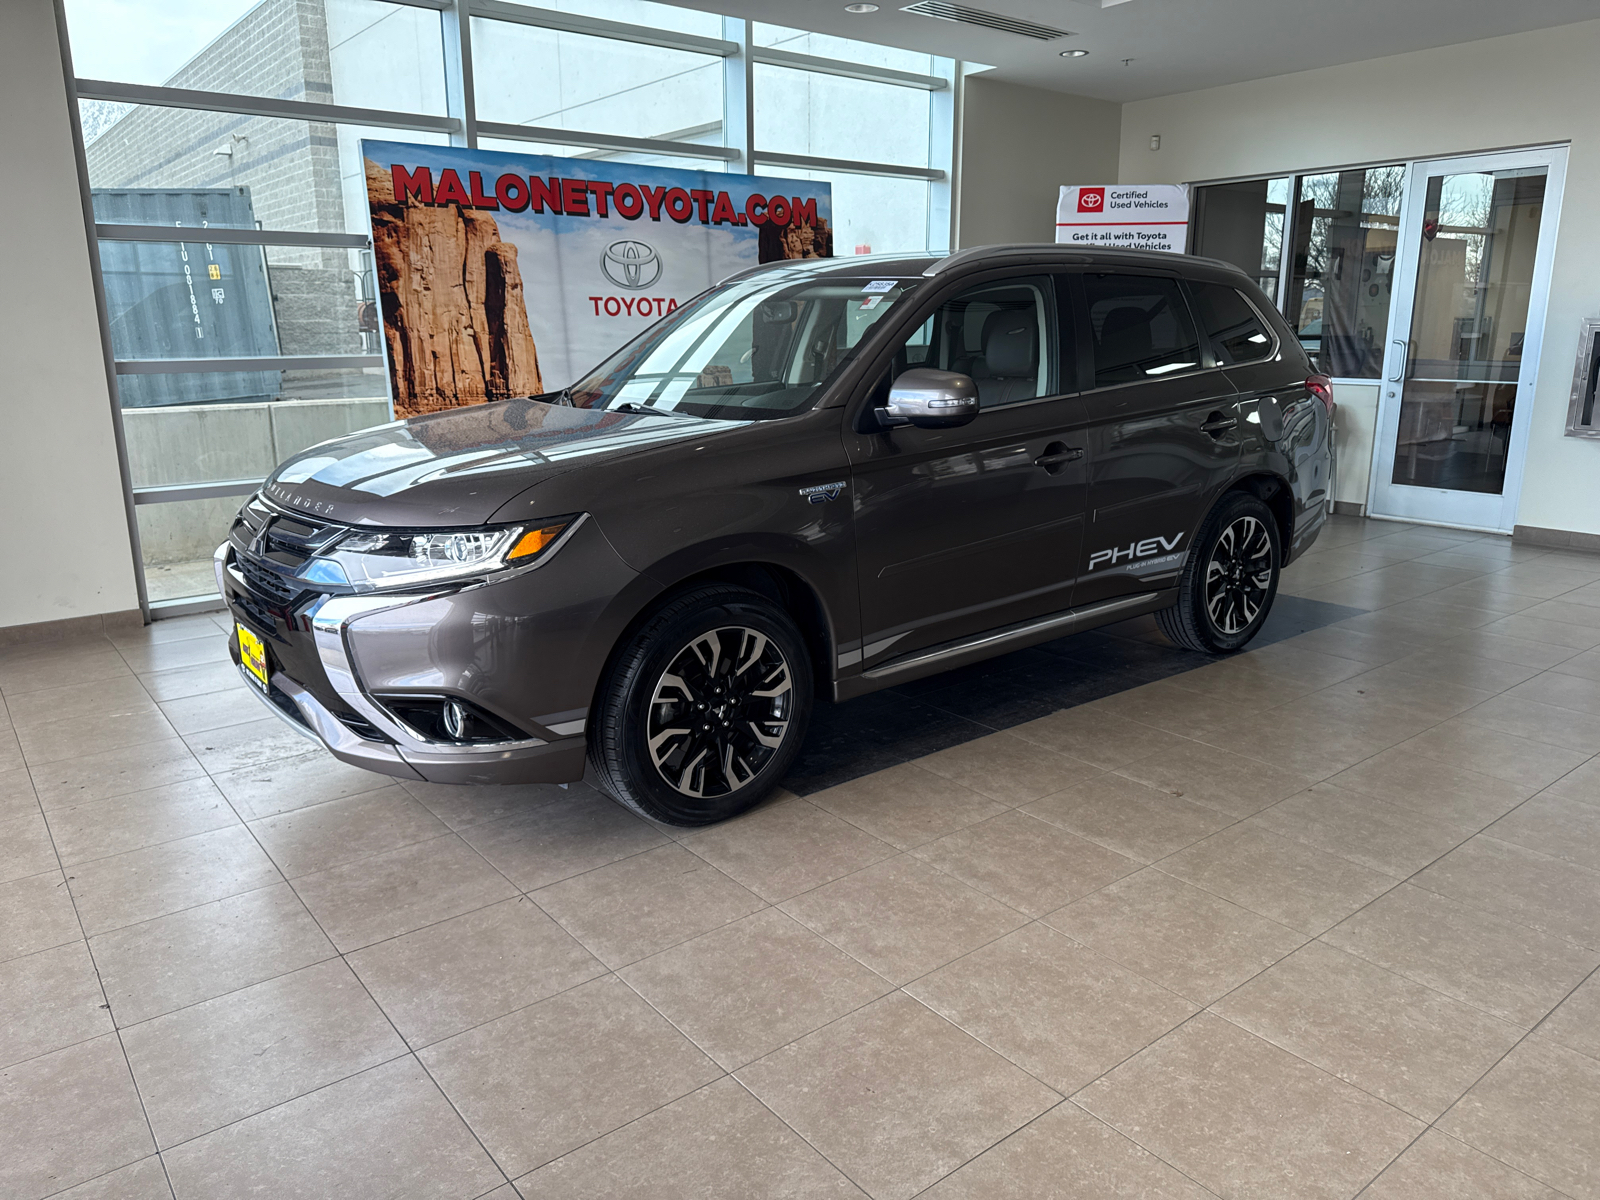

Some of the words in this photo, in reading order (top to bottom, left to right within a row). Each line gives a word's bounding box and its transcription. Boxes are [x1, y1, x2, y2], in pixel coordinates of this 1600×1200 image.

[391, 164, 818, 228] MALONETOYOTA.COM
[1110, 191, 1148, 199] Certified
[1134, 200, 1169, 208] Vehicles
[1072, 233, 1089, 241] Get
[1099, 232, 1112, 240] all
[1113, 232, 1134, 240] with
[1136, 232, 1167, 242] Toyota
[1134, 242, 1172, 250] Vehicles
[588, 296, 679, 317] TOYOTA
[808, 488, 842, 505] EV
[1088, 531, 1185, 571] PHEV
[1167, 553, 1181, 561] EV
